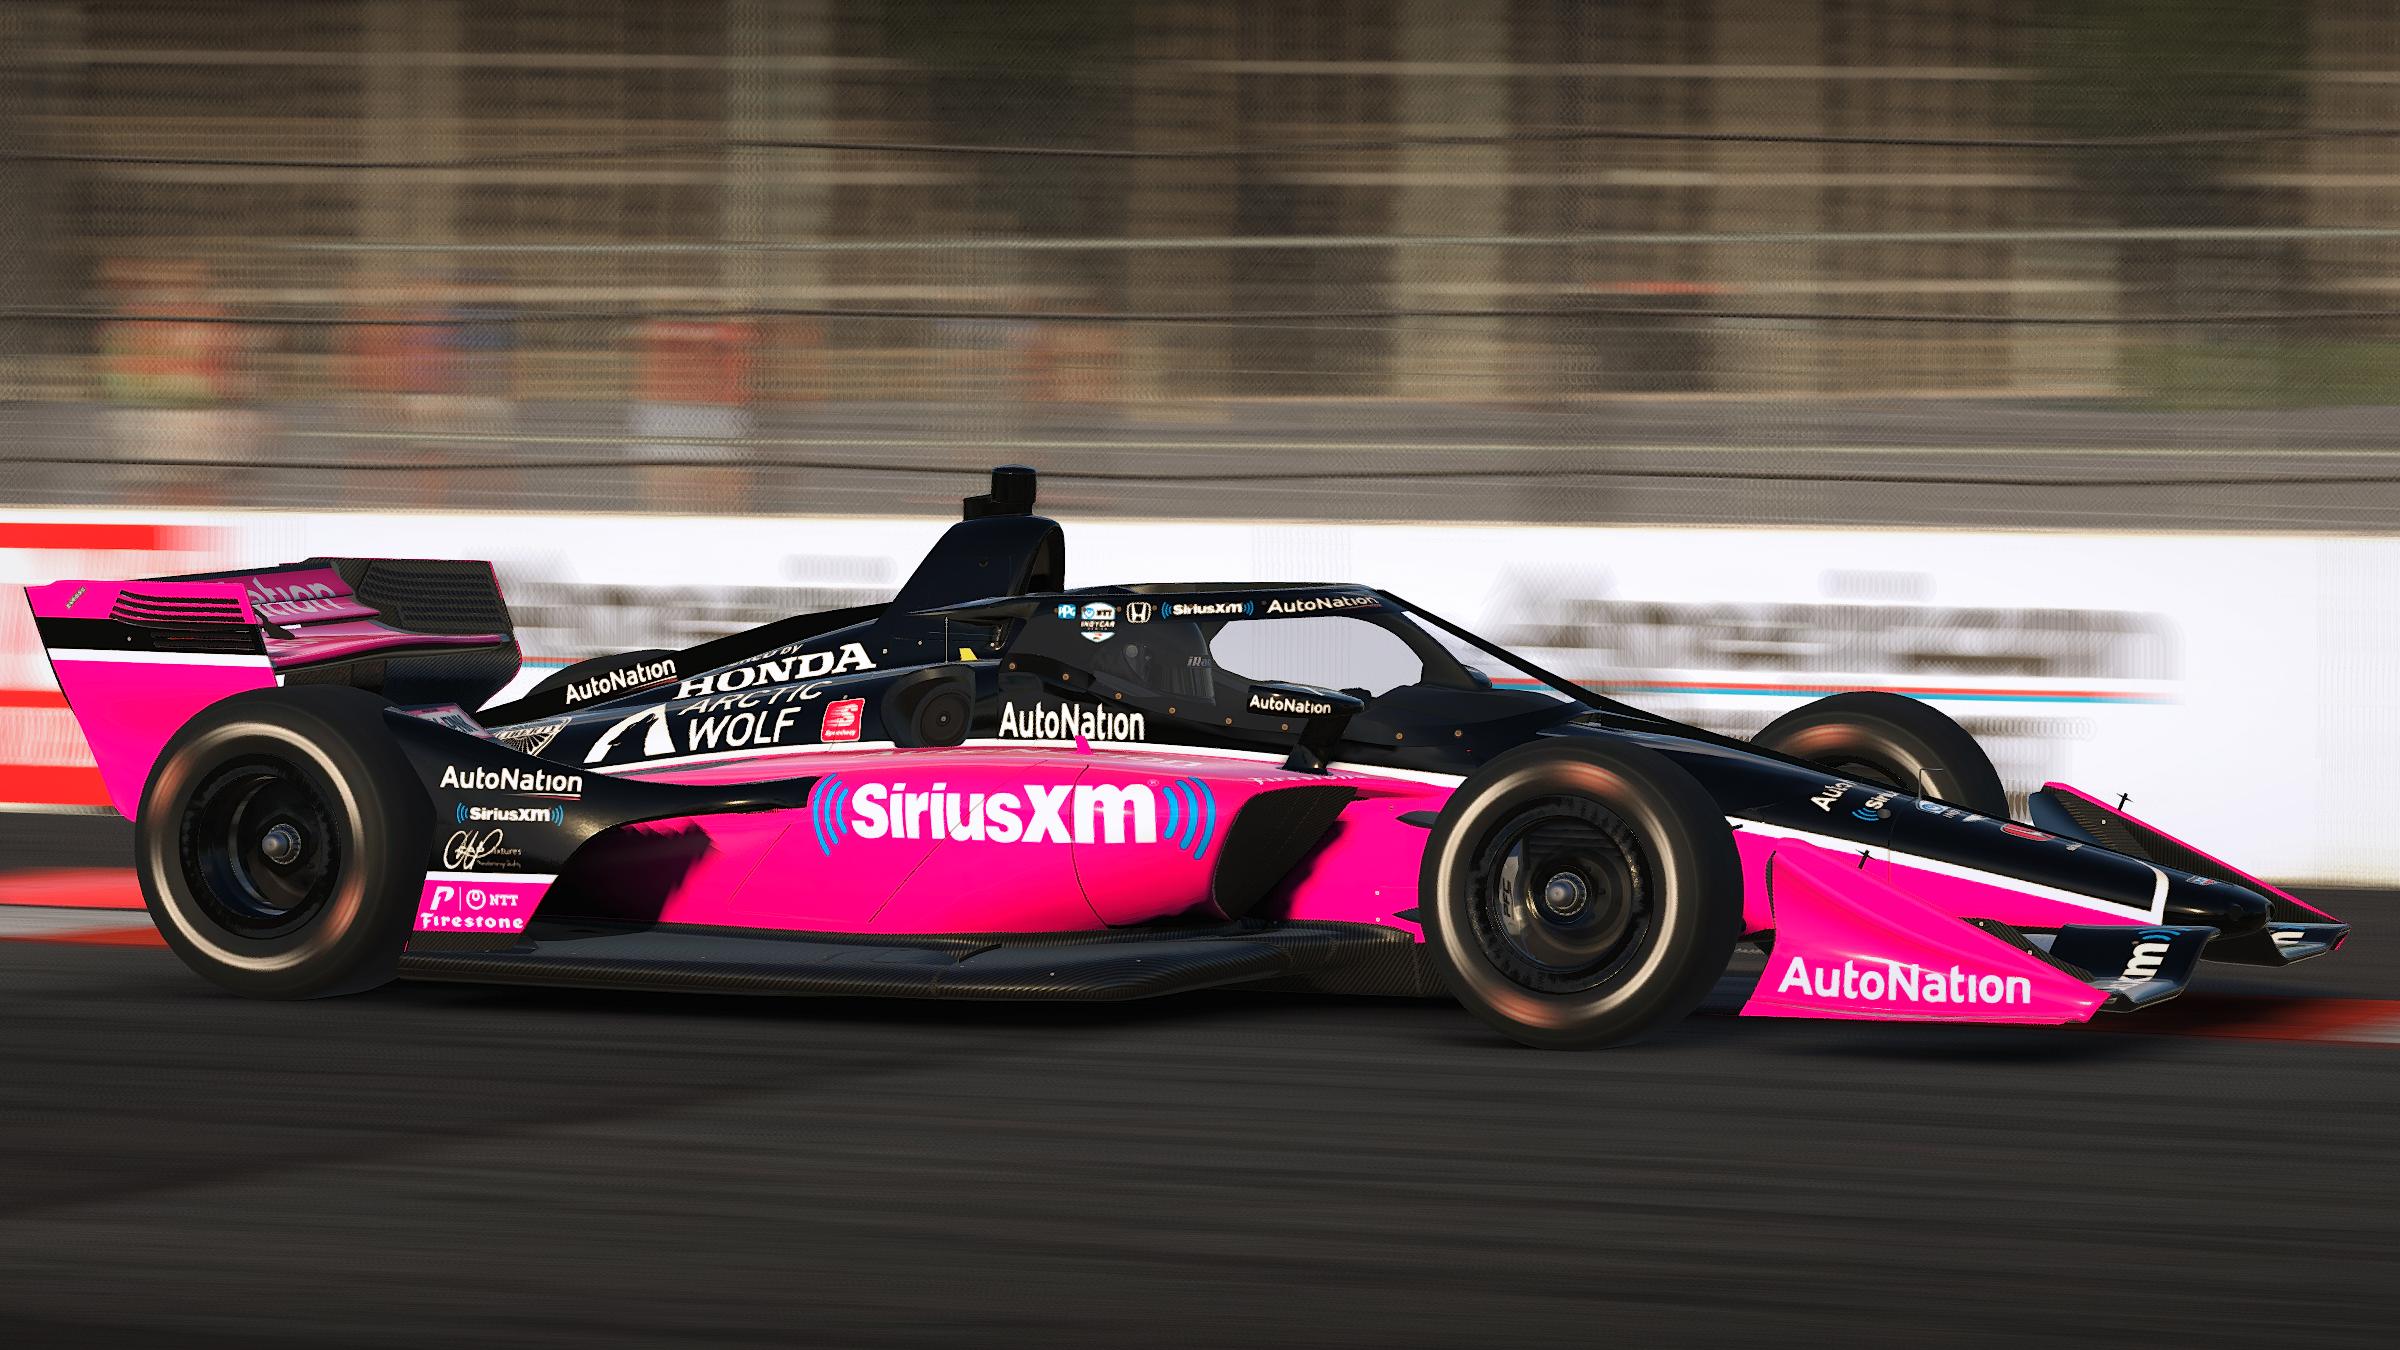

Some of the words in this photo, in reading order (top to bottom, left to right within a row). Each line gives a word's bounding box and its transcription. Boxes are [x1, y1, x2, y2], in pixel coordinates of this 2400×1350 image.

[1266, 596, 1379, 614] AutoNation
[566, 658, 677, 704] AutoNation
[672, 642, 877, 700] HONDA
[677, 681, 833, 716] ARCTIC
[1250, 694, 1331, 714] AutoNation
[688, 707, 801, 751] WOLF
[999, 701, 1145, 741] AutoNation
[440, 765, 583, 792] AutoNation
[489, 894, 519, 906] NTT
[420, 912, 524, 929] Firestone
[1777, 956, 2032, 1004] AutoNation
